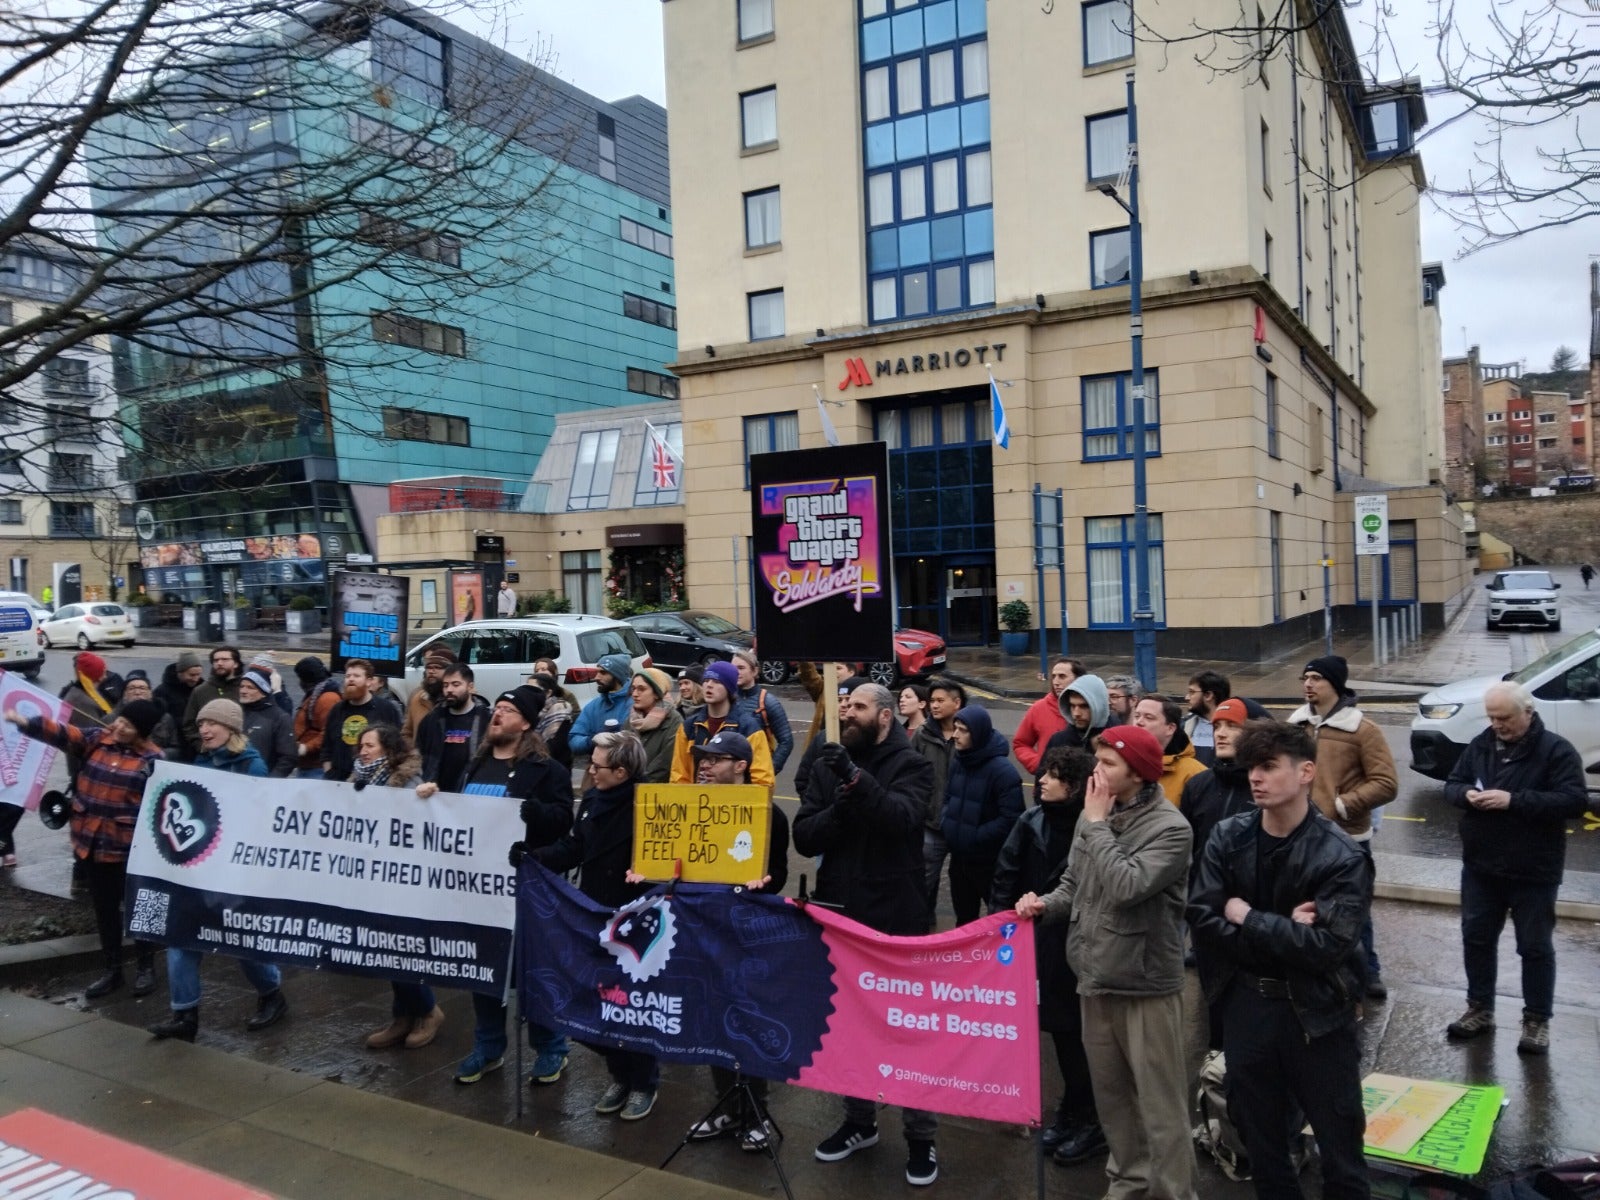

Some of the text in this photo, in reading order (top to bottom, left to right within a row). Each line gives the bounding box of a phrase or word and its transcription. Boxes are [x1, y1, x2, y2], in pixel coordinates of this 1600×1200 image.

[876, 343, 1007, 378] MARRIOTT
[785, 489, 848, 523] grand
[797, 516, 863, 541] theft
[789, 538, 859, 566] wages
[773, 559, 870, 613] Solidarity
[643, 793, 753, 825] UNION BUSTIN
[272, 805, 475, 857] SAY SORRY, BE NICE!
[643, 822, 709, 842] MAKES ME
[642, 840, 720, 864] FEEL BAD
[230, 840, 517, 899] REINSTATE YOUR FIRED WORKERS
[222, 908, 477, 961] ROCKSTAR GAMES WORKERS UNION
[197, 926, 495, 984] JOIN US IN SOLIDARITY WWW.GAMEWORKERS.CO.UK
[629, 990, 683, 1015] GAME
[858, 971, 1017, 1007] Game Workers
[601, 1002, 682, 1035] WORKERS
[887, 1007, 1018, 1041] Beat Bosses
[894, 1067, 1021, 1098] gameworkers.co.uk
